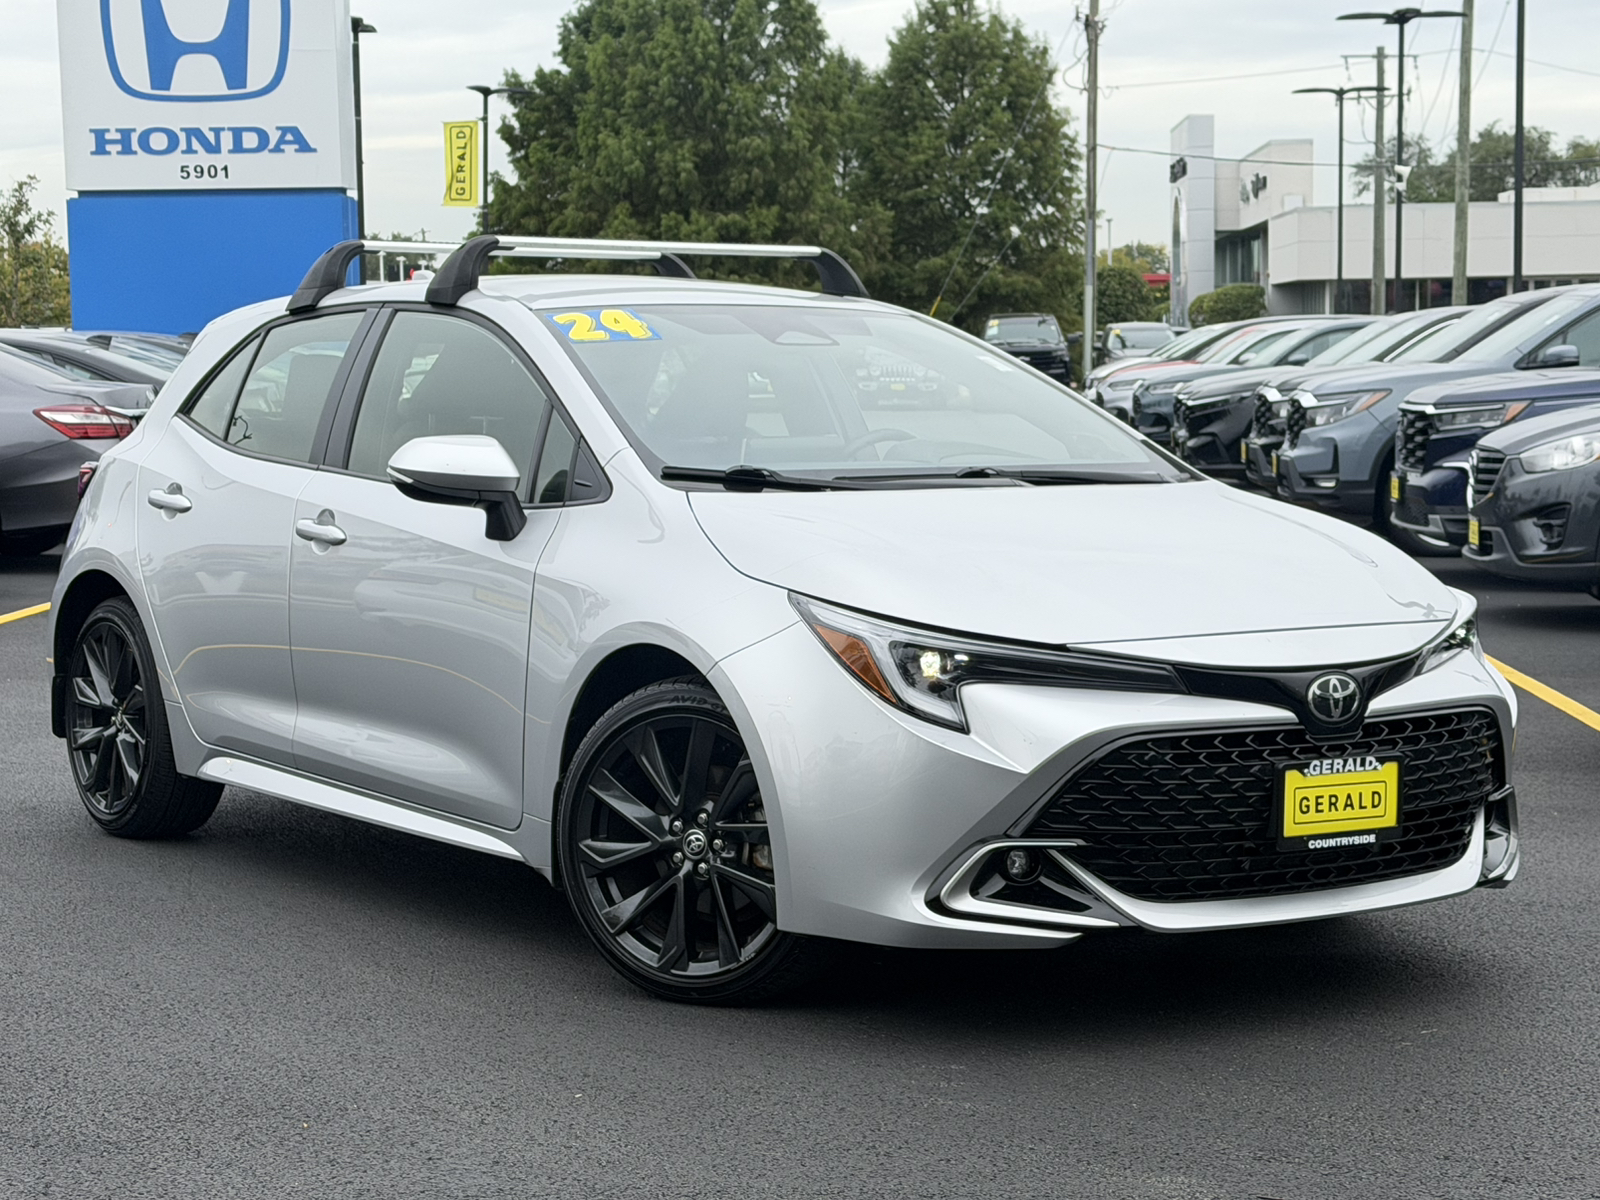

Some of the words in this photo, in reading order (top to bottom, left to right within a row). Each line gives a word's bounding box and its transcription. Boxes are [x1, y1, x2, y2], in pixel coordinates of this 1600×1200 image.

[89, 126, 318, 156] HONDA
[180, 164, 230, 180] 5901
[455, 130, 467, 196] GERALD
[554, 309, 652, 341] 24
[1309, 756, 1376, 775] GERALD
[1299, 790, 1382, 815] GERALD
[1308, 834, 1376, 849] COUNTRYSIDE
